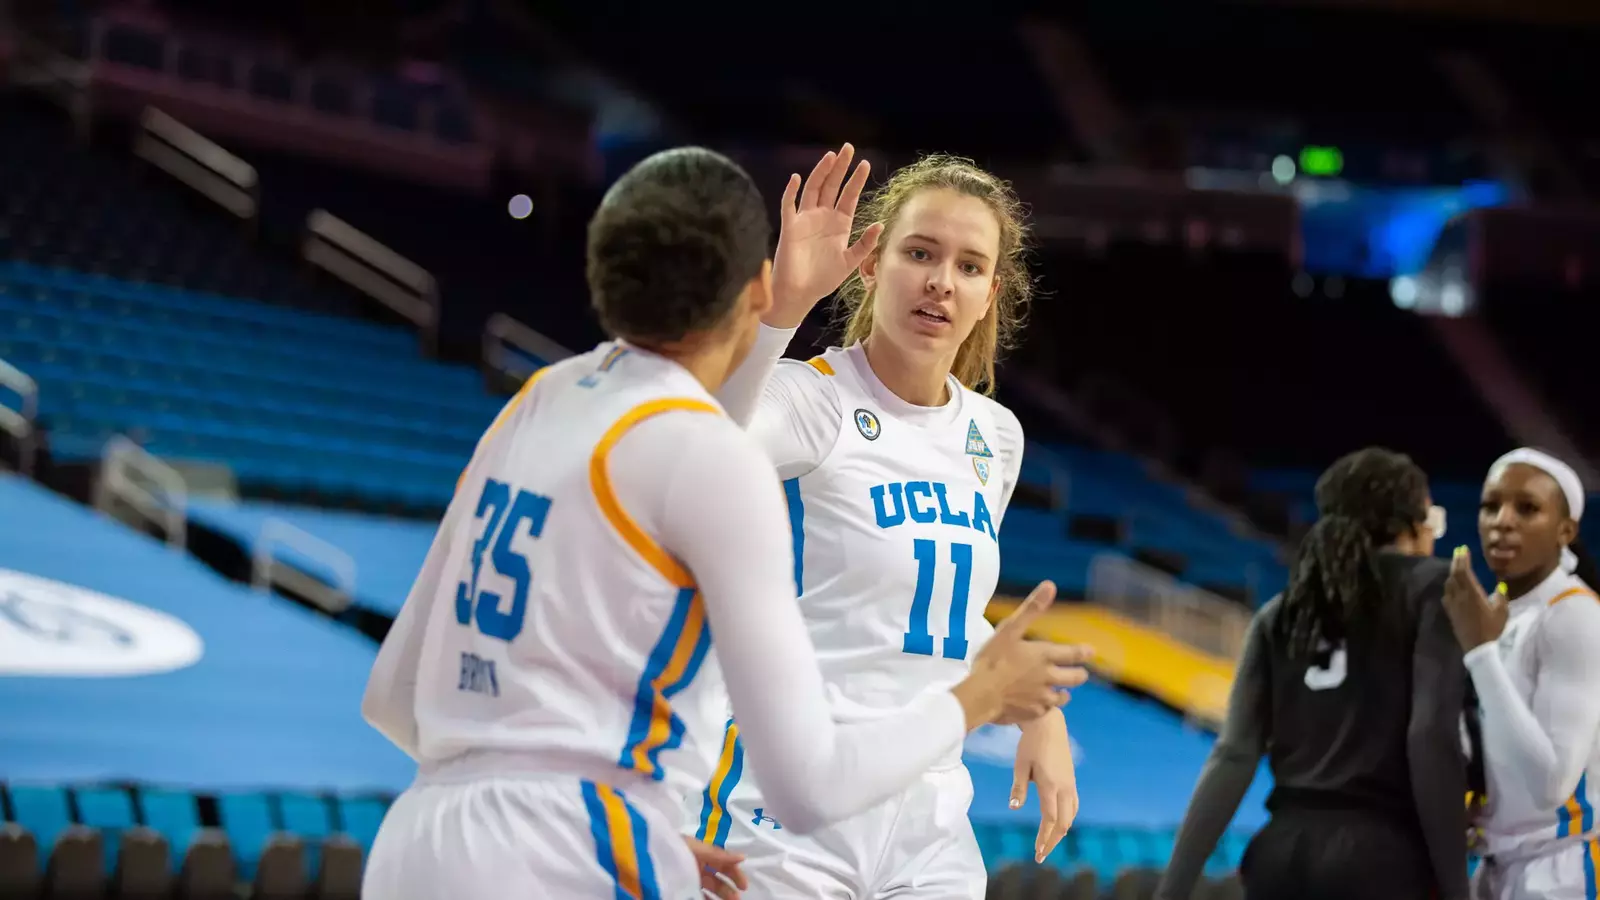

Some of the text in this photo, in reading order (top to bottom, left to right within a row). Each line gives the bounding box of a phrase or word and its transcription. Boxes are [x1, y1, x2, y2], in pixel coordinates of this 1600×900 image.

[455, 477, 553, 643] 35
[869, 481, 998, 543] UCLA
[902, 538, 973, 661] 11
